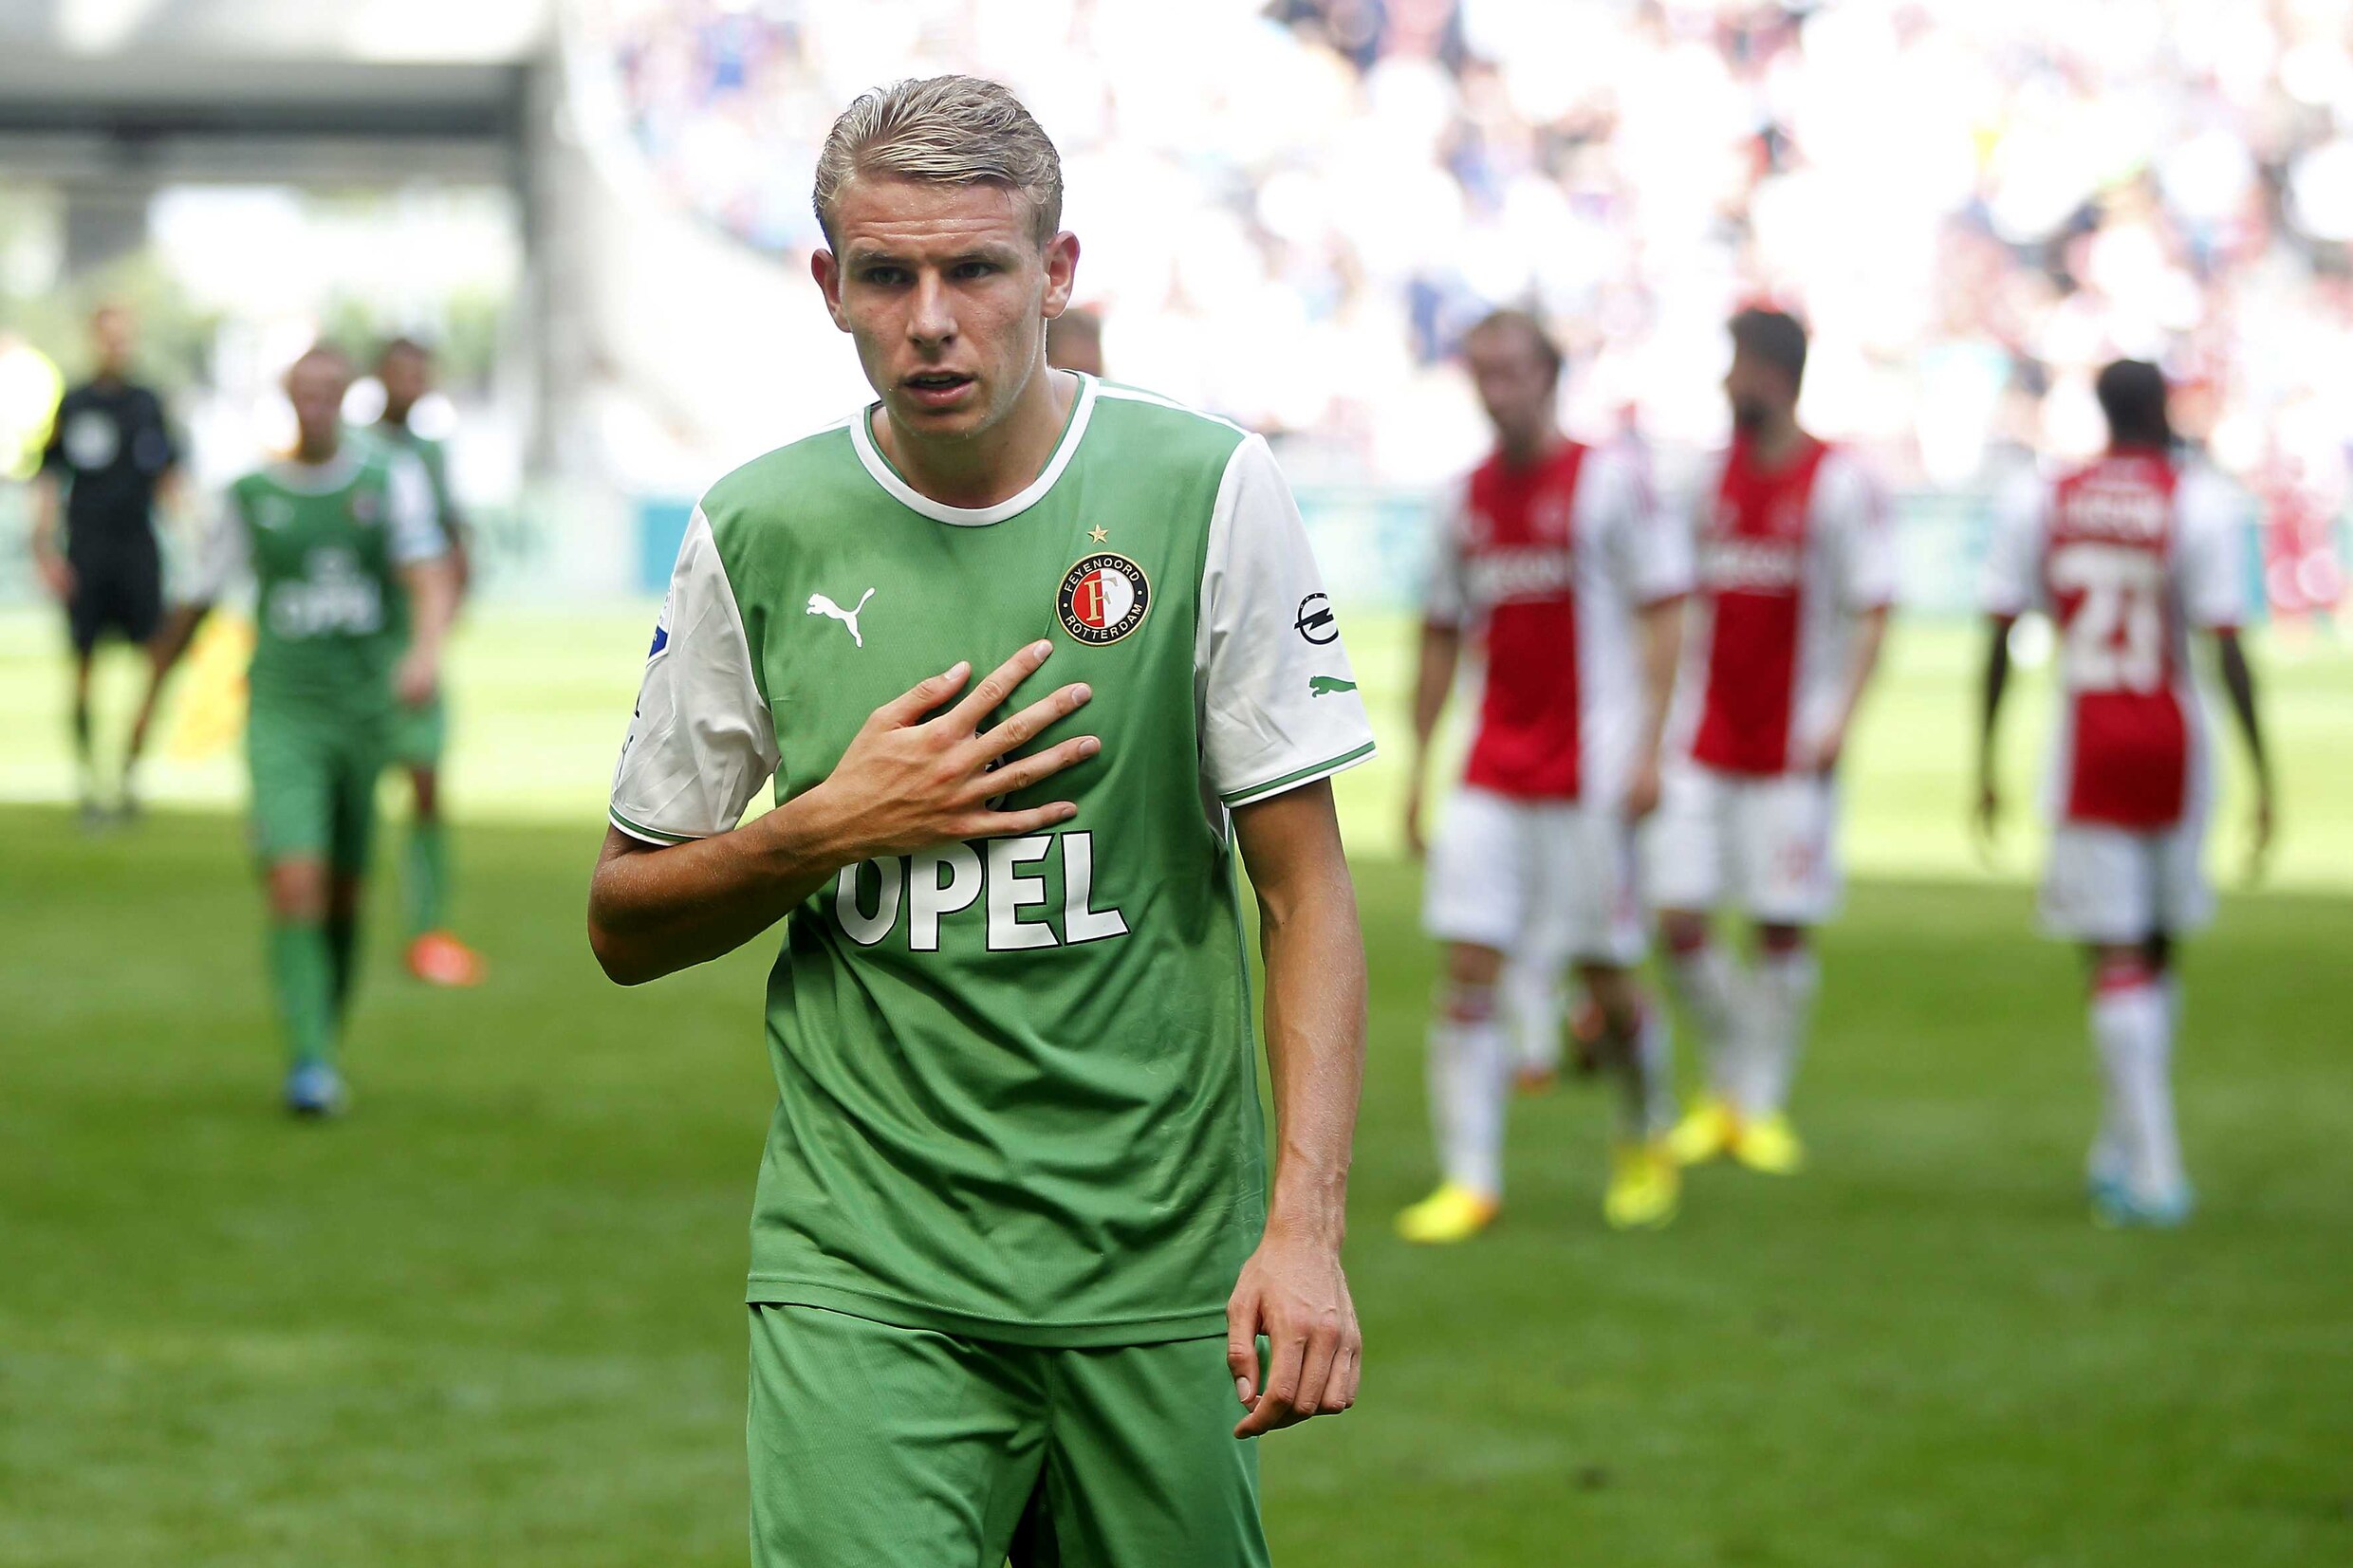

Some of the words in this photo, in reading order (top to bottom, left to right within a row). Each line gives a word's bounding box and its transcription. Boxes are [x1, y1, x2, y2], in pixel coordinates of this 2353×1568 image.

[1064, 557, 1139, 593] FEYENOORD
[1065, 602, 1143, 640] ROTTERDAM
[835, 829, 1131, 952] OPEL
